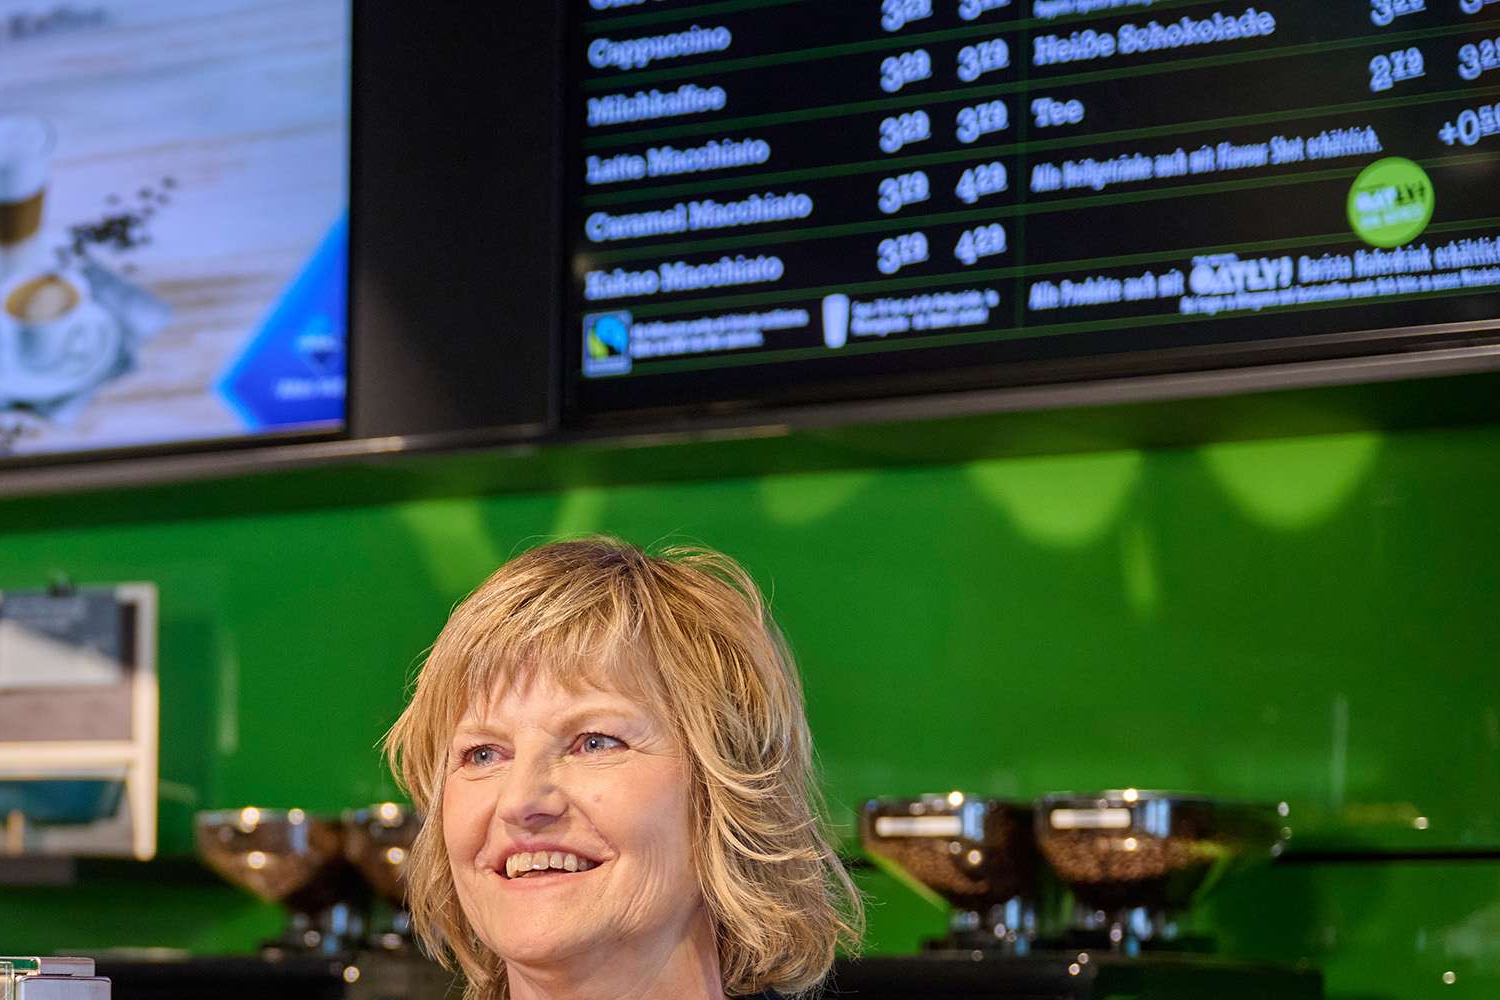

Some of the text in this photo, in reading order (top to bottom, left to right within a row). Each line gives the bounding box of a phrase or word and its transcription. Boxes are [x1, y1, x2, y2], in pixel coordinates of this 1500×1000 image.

[589, 25, 731, 69] Cappuccino
[1034, 30, 1115, 65] Heiße
[1118, 8, 1275, 53] Schokolade
[588, 84, 725, 125] Milchkaffee
[1032, 98, 1084, 126] Tee
[587, 154, 646, 184] Latte
[647, 139, 769, 178] Macchiato
[585, 203, 686, 242] Caramel
[688, 192, 812, 231] Macchiato
[585, 269, 658, 300] Kakao
[660, 255, 783, 292] Macchiato
